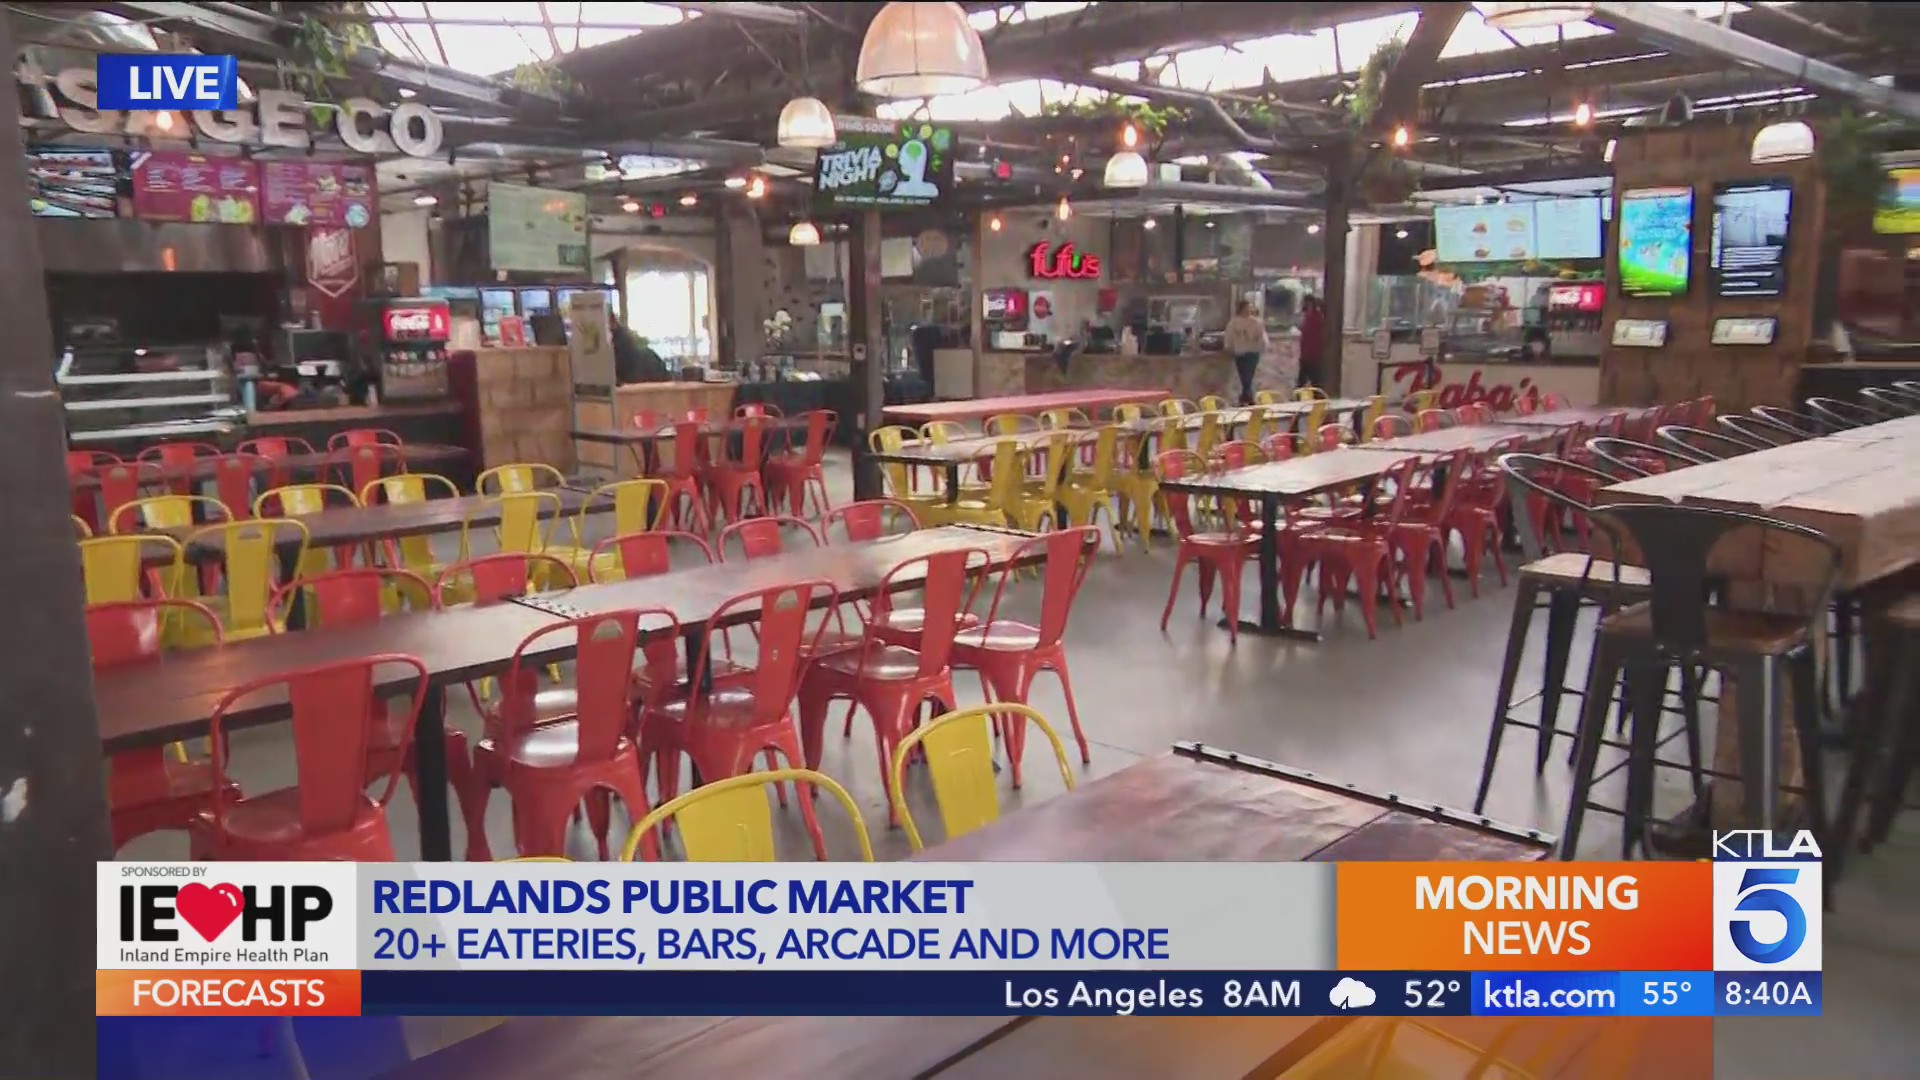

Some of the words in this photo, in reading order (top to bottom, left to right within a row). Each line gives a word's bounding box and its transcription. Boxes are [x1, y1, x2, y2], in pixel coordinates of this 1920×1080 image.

[336, 98, 444, 157] CO
[820, 146, 882, 173] TRIVIA
[818, 160, 878, 192] NIGHT
